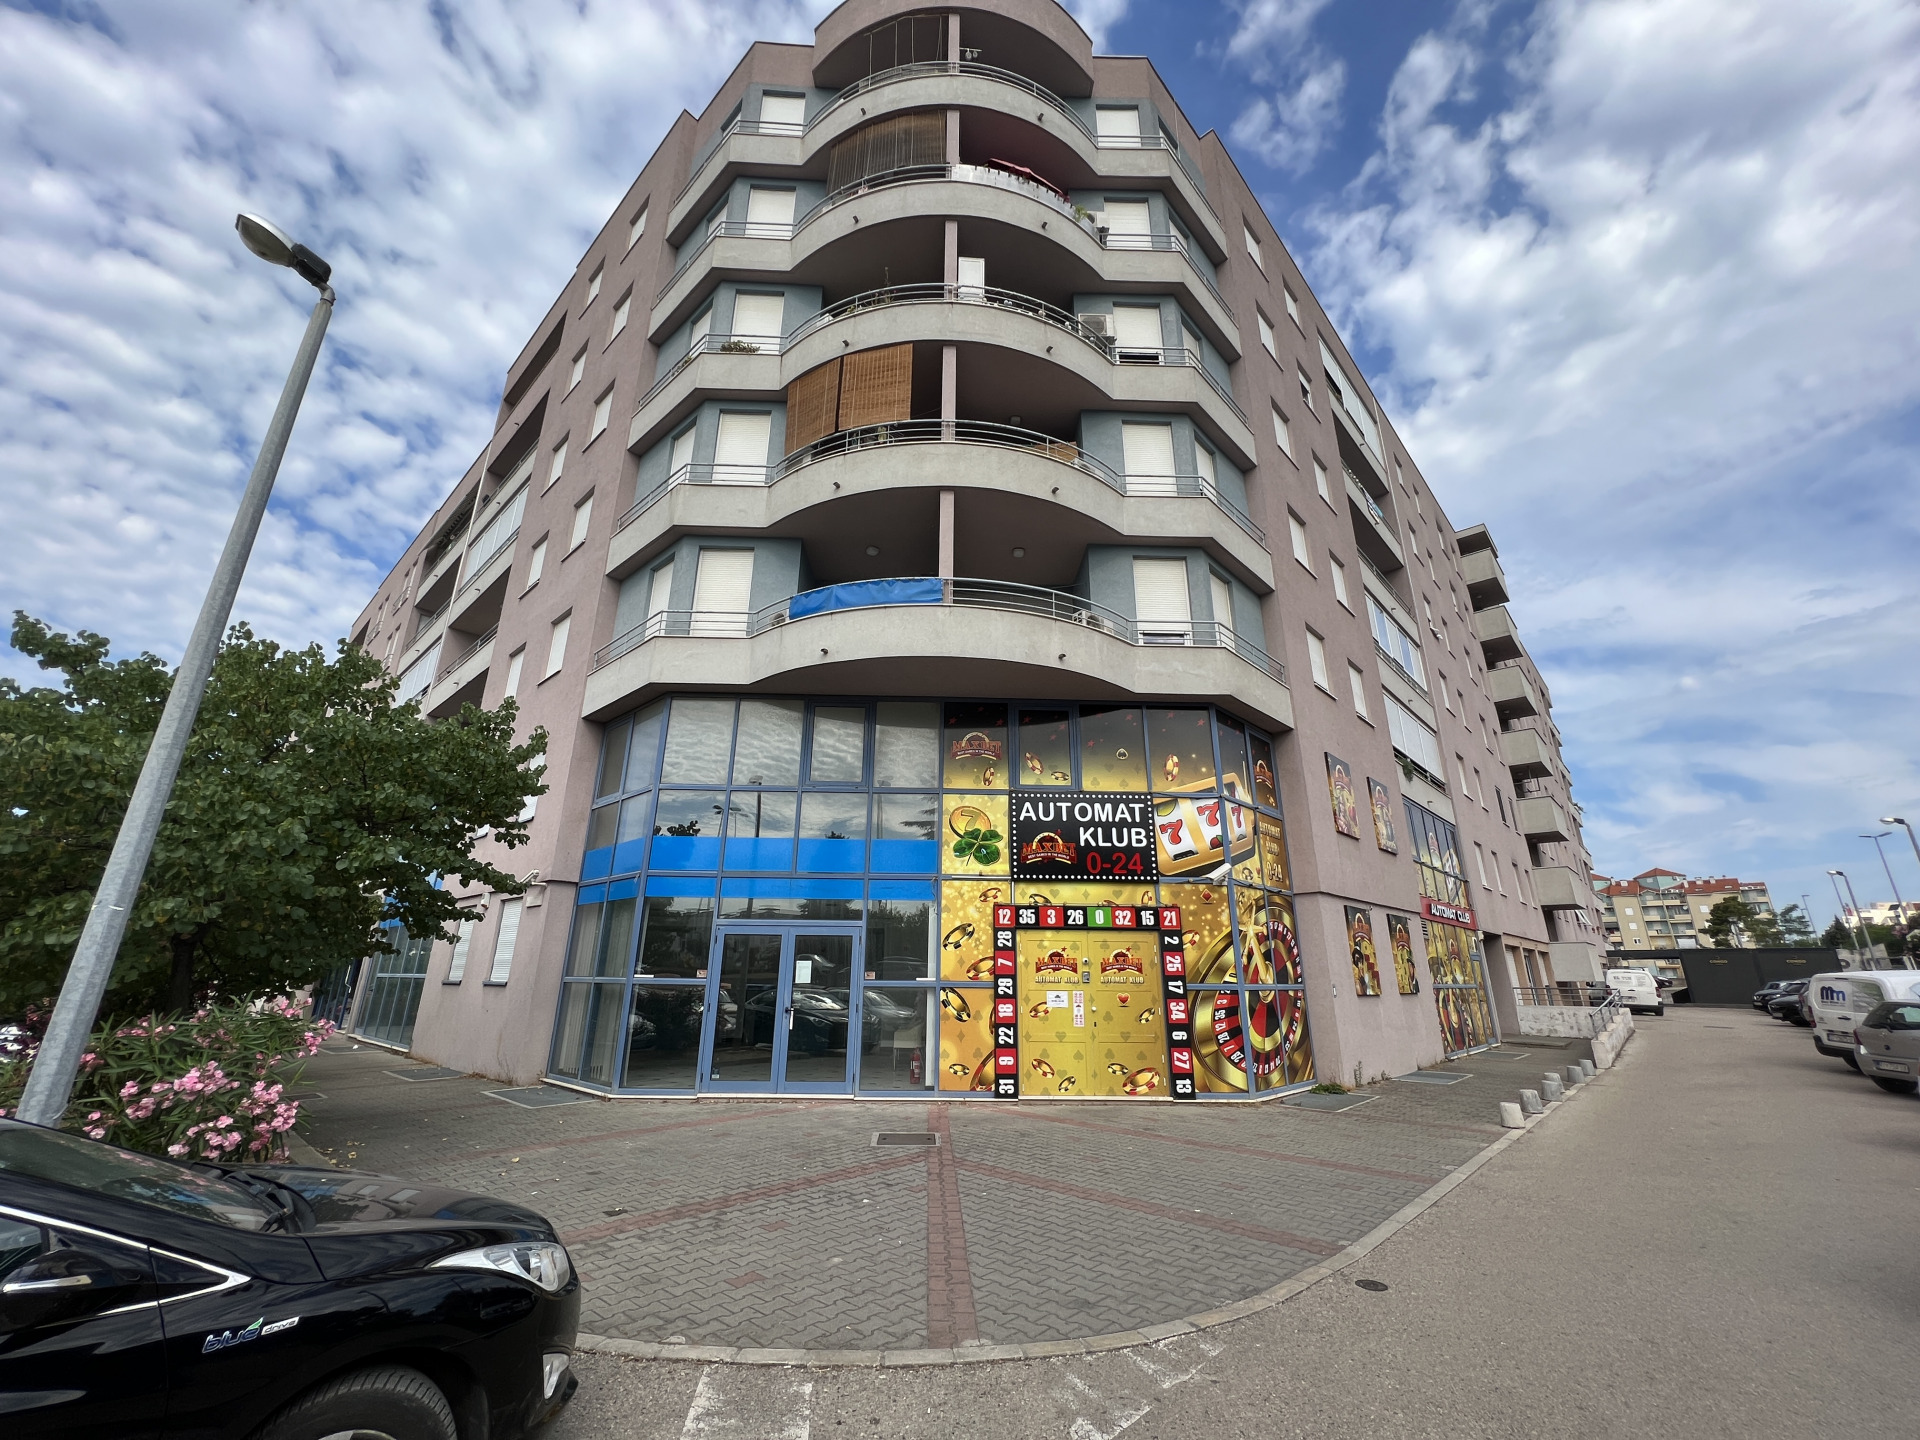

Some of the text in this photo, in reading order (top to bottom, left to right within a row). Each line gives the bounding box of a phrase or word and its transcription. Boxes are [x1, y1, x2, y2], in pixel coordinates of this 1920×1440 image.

[1019, 801, 1145, 822] AUTOMAT
[1079, 827, 1147, 847] KLUB
[1022, 842, 1076, 856] MAXBET
[1086, 852, 1144, 874] 0-24
[998, 908, 1177, 927] 12 35 3 26 0 32 15 21
[997, 930, 1015, 1095] 31 9 22 18 29 7 28
[1164, 936, 1192, 1094] 2 25 17 34 6 27 13
[202, 1320, 297, 1353] blue drive
